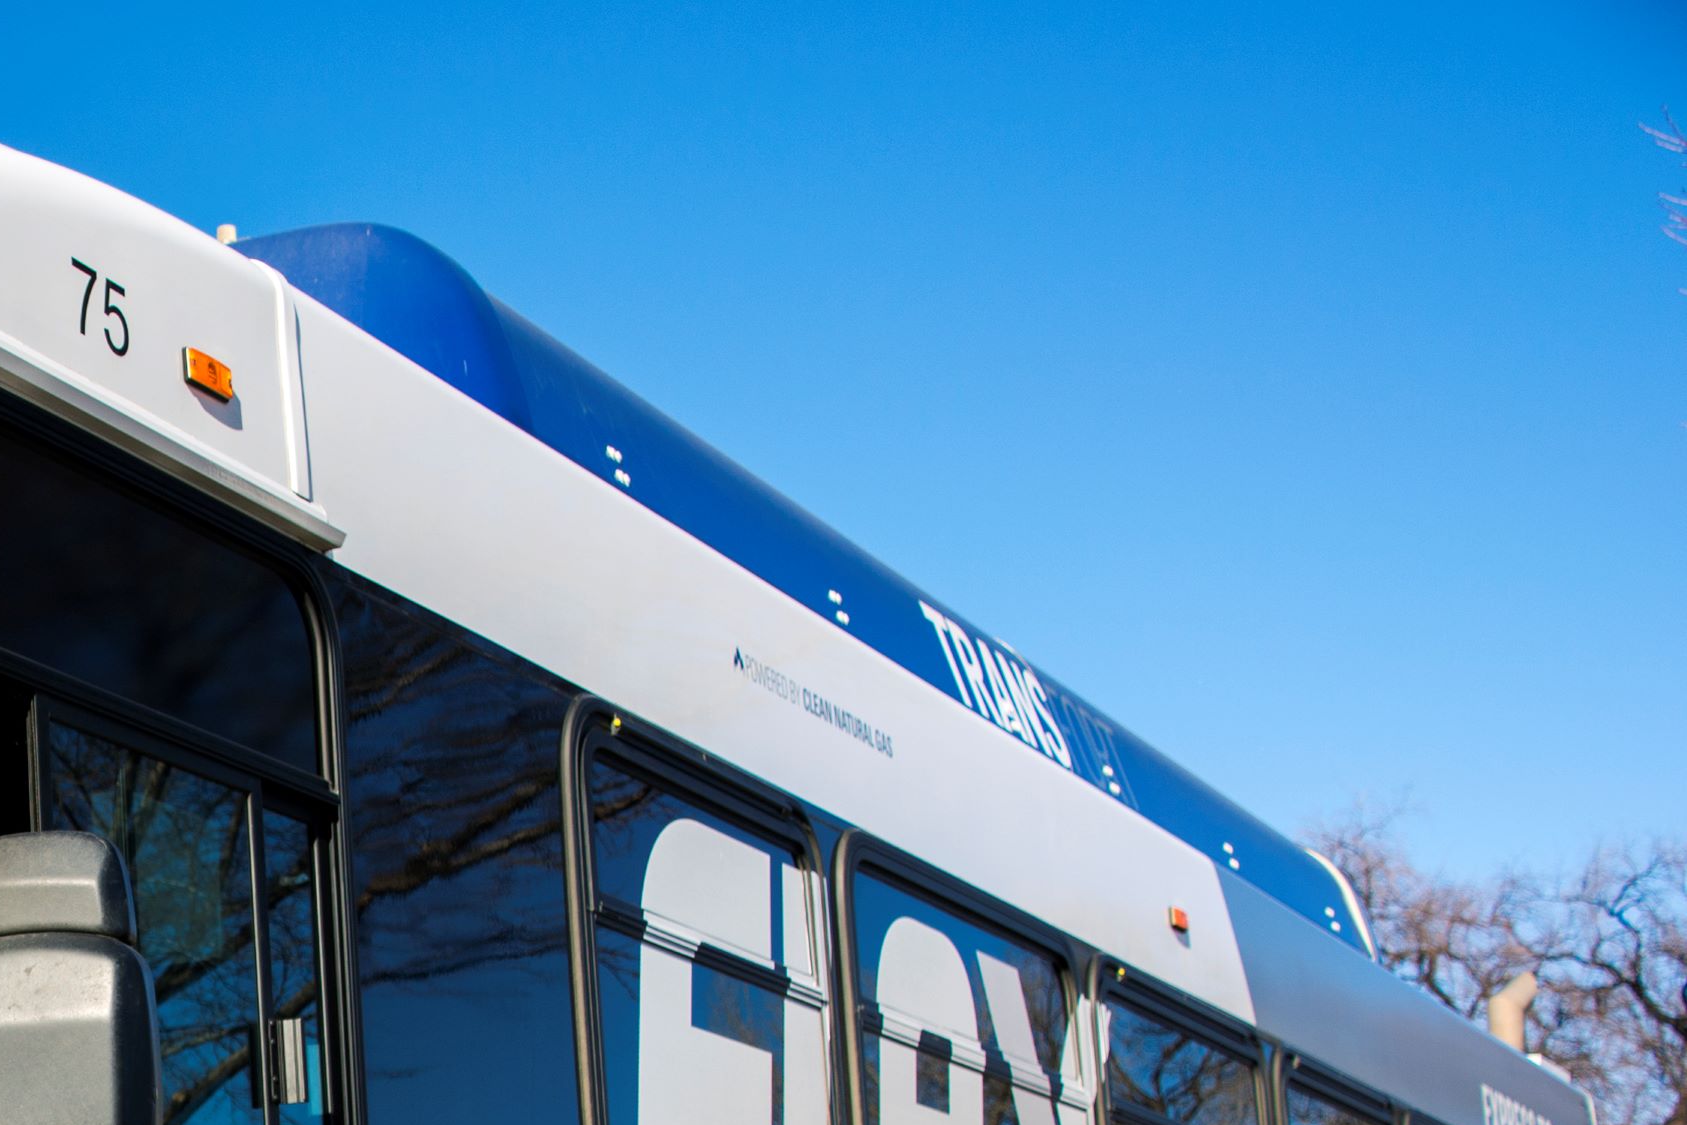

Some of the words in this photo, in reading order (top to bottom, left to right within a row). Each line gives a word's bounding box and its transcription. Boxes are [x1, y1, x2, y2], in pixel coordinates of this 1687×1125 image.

[71, 256, 130, 357] 75
[744, 654, 789, 700] POWERED
[803, 688, 833, 724] CLEAN
[833, 705, 874, 747] NATURAL
[875, 729, 893, 758] GAS
